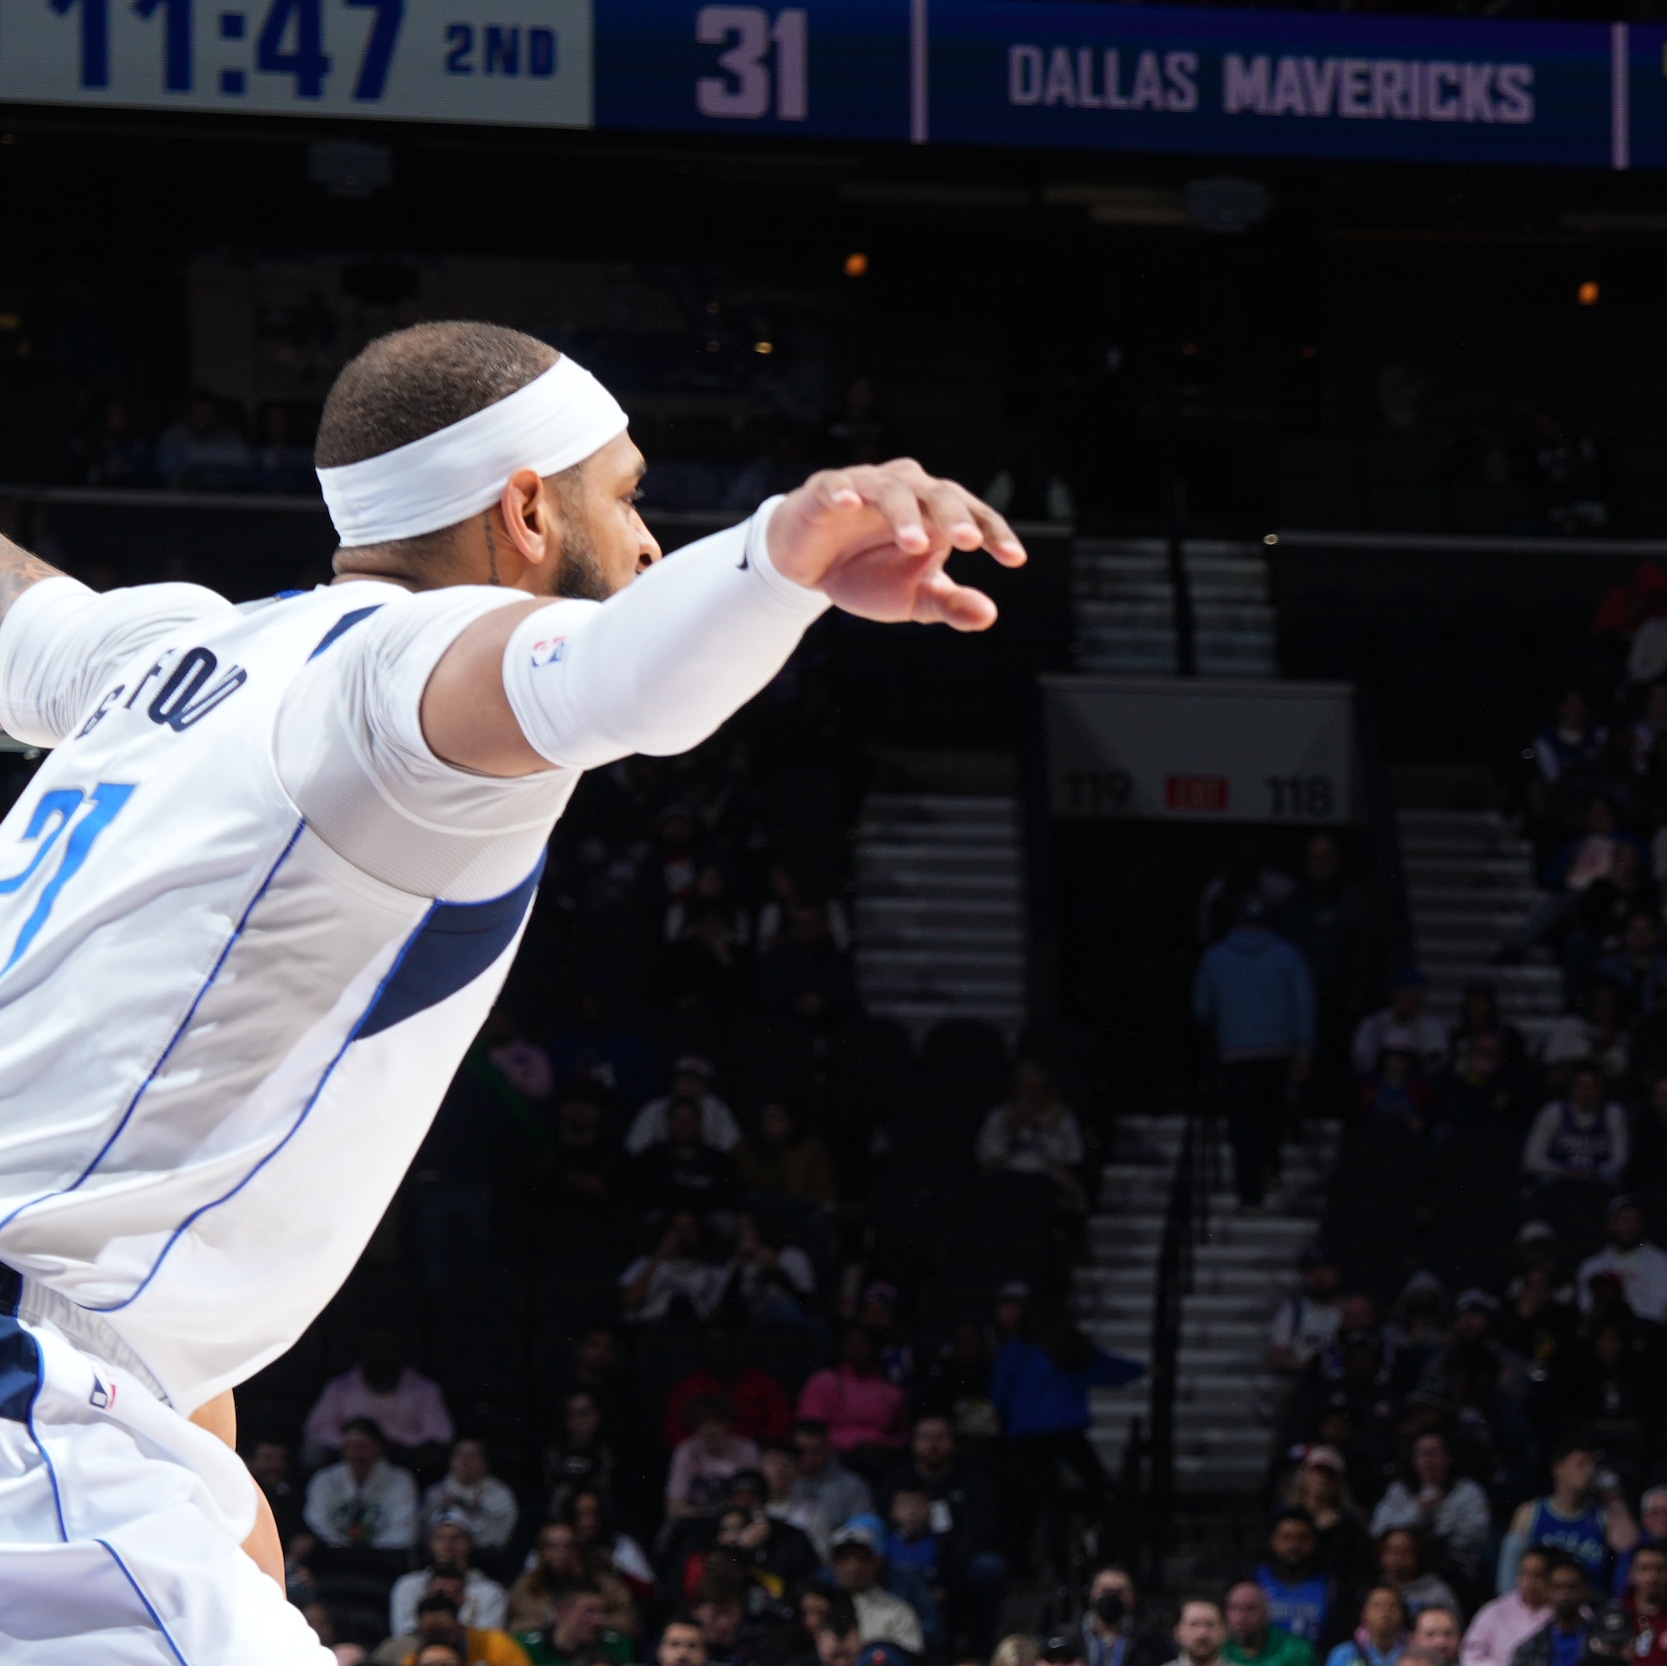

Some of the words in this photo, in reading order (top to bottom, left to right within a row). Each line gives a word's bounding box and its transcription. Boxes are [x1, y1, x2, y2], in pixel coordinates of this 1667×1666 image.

[48, 0, 407, 102] 11:47
[444, 23, 558, 77] 2ND
[695, 5, 808, 121] 31
[1009, 44, 1199, 113] DALLAS
[1222, 53, 1535, 125] MAVERICKS
[1065, 768, 1134, 809] 119
[1266, 774, 1333, 817] 118
